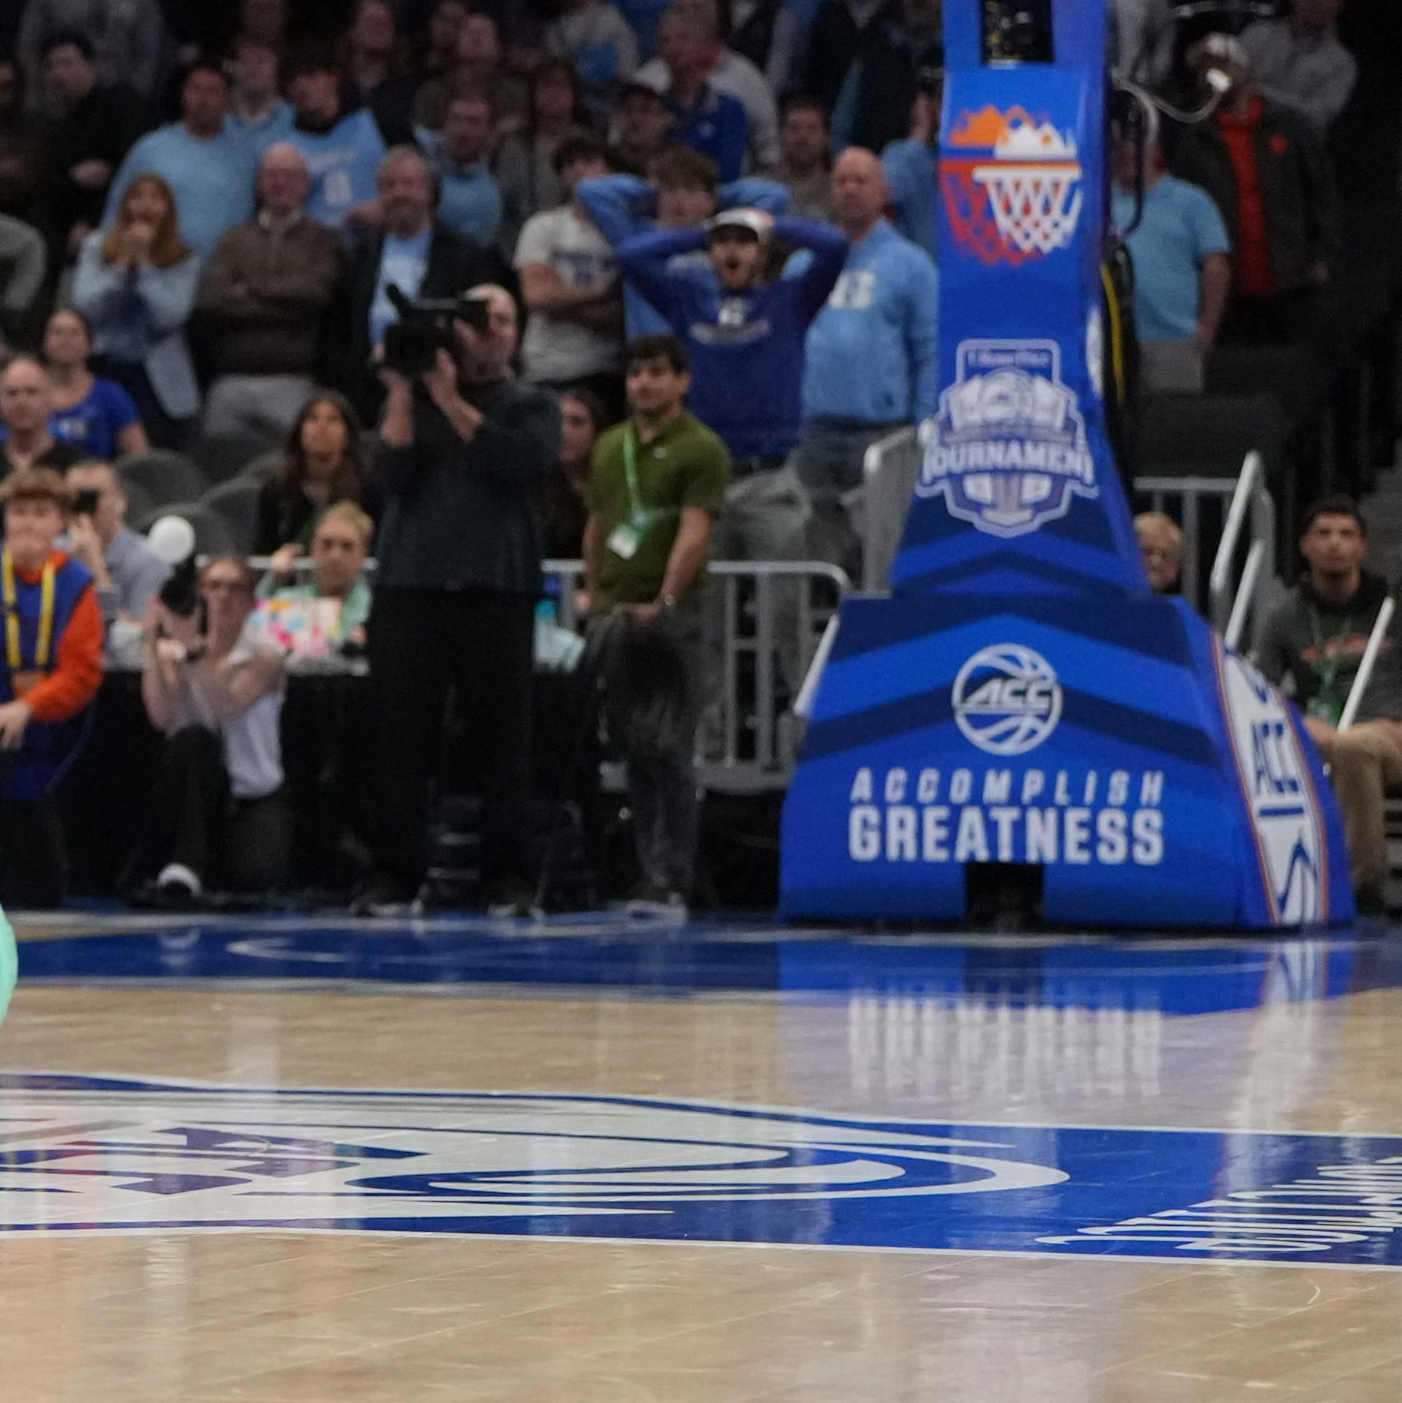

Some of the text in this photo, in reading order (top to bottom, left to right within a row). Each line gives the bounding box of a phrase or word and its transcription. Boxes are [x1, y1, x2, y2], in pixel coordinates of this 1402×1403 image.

[966, 676, 1054, 707] ACC
[850, 767, 1164, 807] ACCOMPLISH
[848, 804, 1165, 866] GREATNESS
